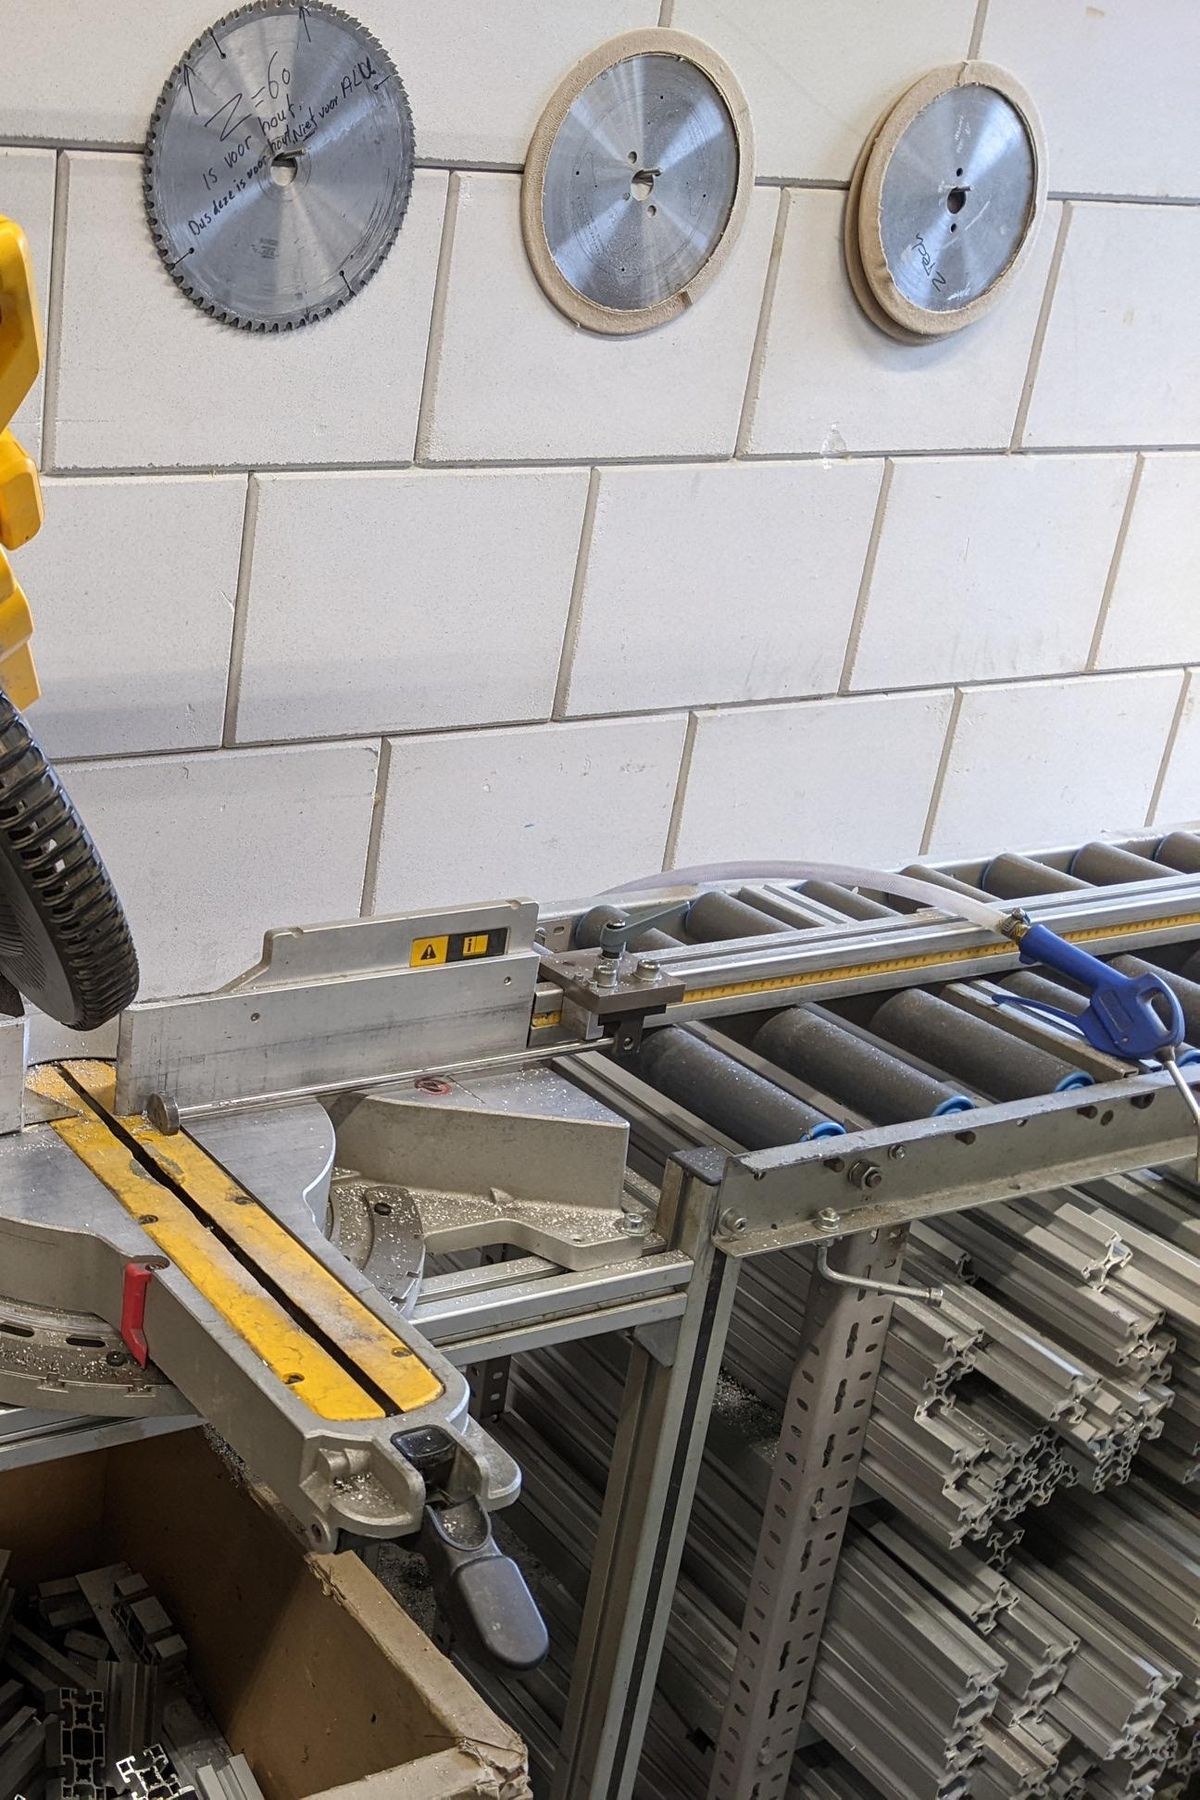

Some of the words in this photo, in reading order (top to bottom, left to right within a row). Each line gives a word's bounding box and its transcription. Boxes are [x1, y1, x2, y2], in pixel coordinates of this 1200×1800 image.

[188, 213, 212, 236] Dus
[212, 190, 235, 216] deze
[233, 178, 247, 192] is
[246, 155, 267, 179] voor
